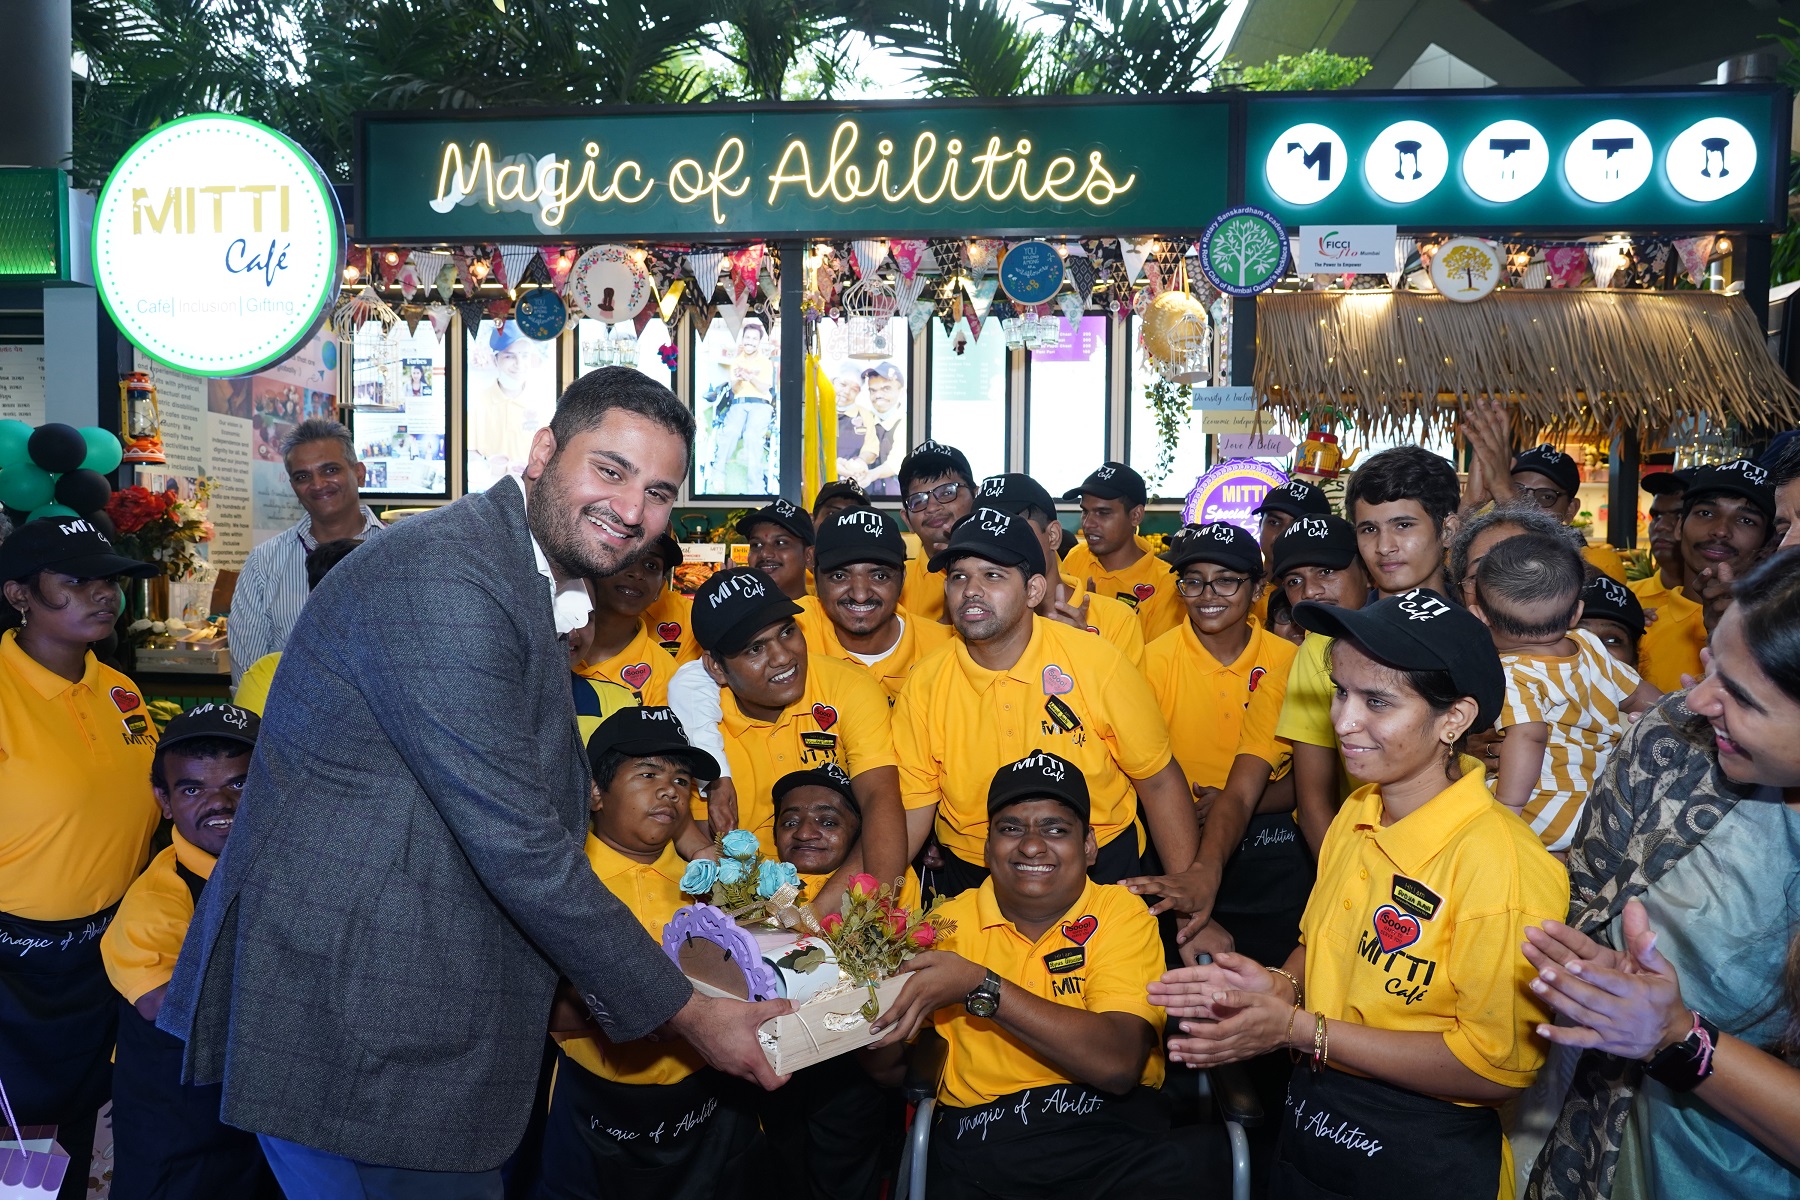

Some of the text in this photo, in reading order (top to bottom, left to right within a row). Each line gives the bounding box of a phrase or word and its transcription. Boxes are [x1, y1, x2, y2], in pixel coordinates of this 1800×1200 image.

[436, 120, 1136, 227] Magic of Abilities
[132, 185, 290, 235] MITTI
[1203, 206, 1286, 243] Rotary Sanskardham Academy
[1024, 247, 1037, 255] YOU
[1326, 241, 1350, 249] FICCI
[225, 238, 292, 287] Café
[1335, 248, 1358, 260] flo
[1202, 247, 1288, 294] Rotary Club of Mumbai Queen's Necklace
[246, 297, 294, 315] Gifting
[1194, 393, 1222, 406] Diversity
[1203, 417, 1230, 425] Economic
[1224, 439, 1243, 450] Love
[1256, 441, 1281, 453] Belief
[1715, 459, 1768, 478] MITTI
[1743, 471, 1765, 486] Café
[1290, 490, 1306, 501] Café
[776, 507, 794, 518] Café
[837, 510, 883, 527] MITTI
[1205, 504, 1251, 523] Special
[864, 524, 883, 538] Café
[981, 521, 1006, 537] Café
[1193, 524, 1234, 540] MITTI
[1284, 517, 1328, 538] MITTI
[1308, 526, 1329, 539] Café
[1214, 533, 1234, 544] Café
[709, 573, 758, 609] MITTI
[743, 583, 766, 600] Café
[1605, 591, 1628, 607] Café
[1398, 602, 1434, 621] Café
[626, 668, 647, 677] Sooo!
[1048, 669, 1068, 688] Sooo!
[223, 713, 248, 730] Café
[814, 708, 832, 718] Sooo!
[1012, 753, 1065, 772] MITTI
[1042, 766, 1065, 783] Café
[1254, 827, 1296, 847] Abilities
[1067, 921, 1091, 932] Sooo!
[1380, 913, 1411, 936] Sooo!
[60, 930, 75, 952] of
[1357, 929, 1437, 986] MITTI
[1384, 977, 1428, 1006] Café
[956, 1090, 1031, 1141] Magic of
[649, 1121, 665, 1144] of
[1303, 1110, 1383, 1157] Abilities
